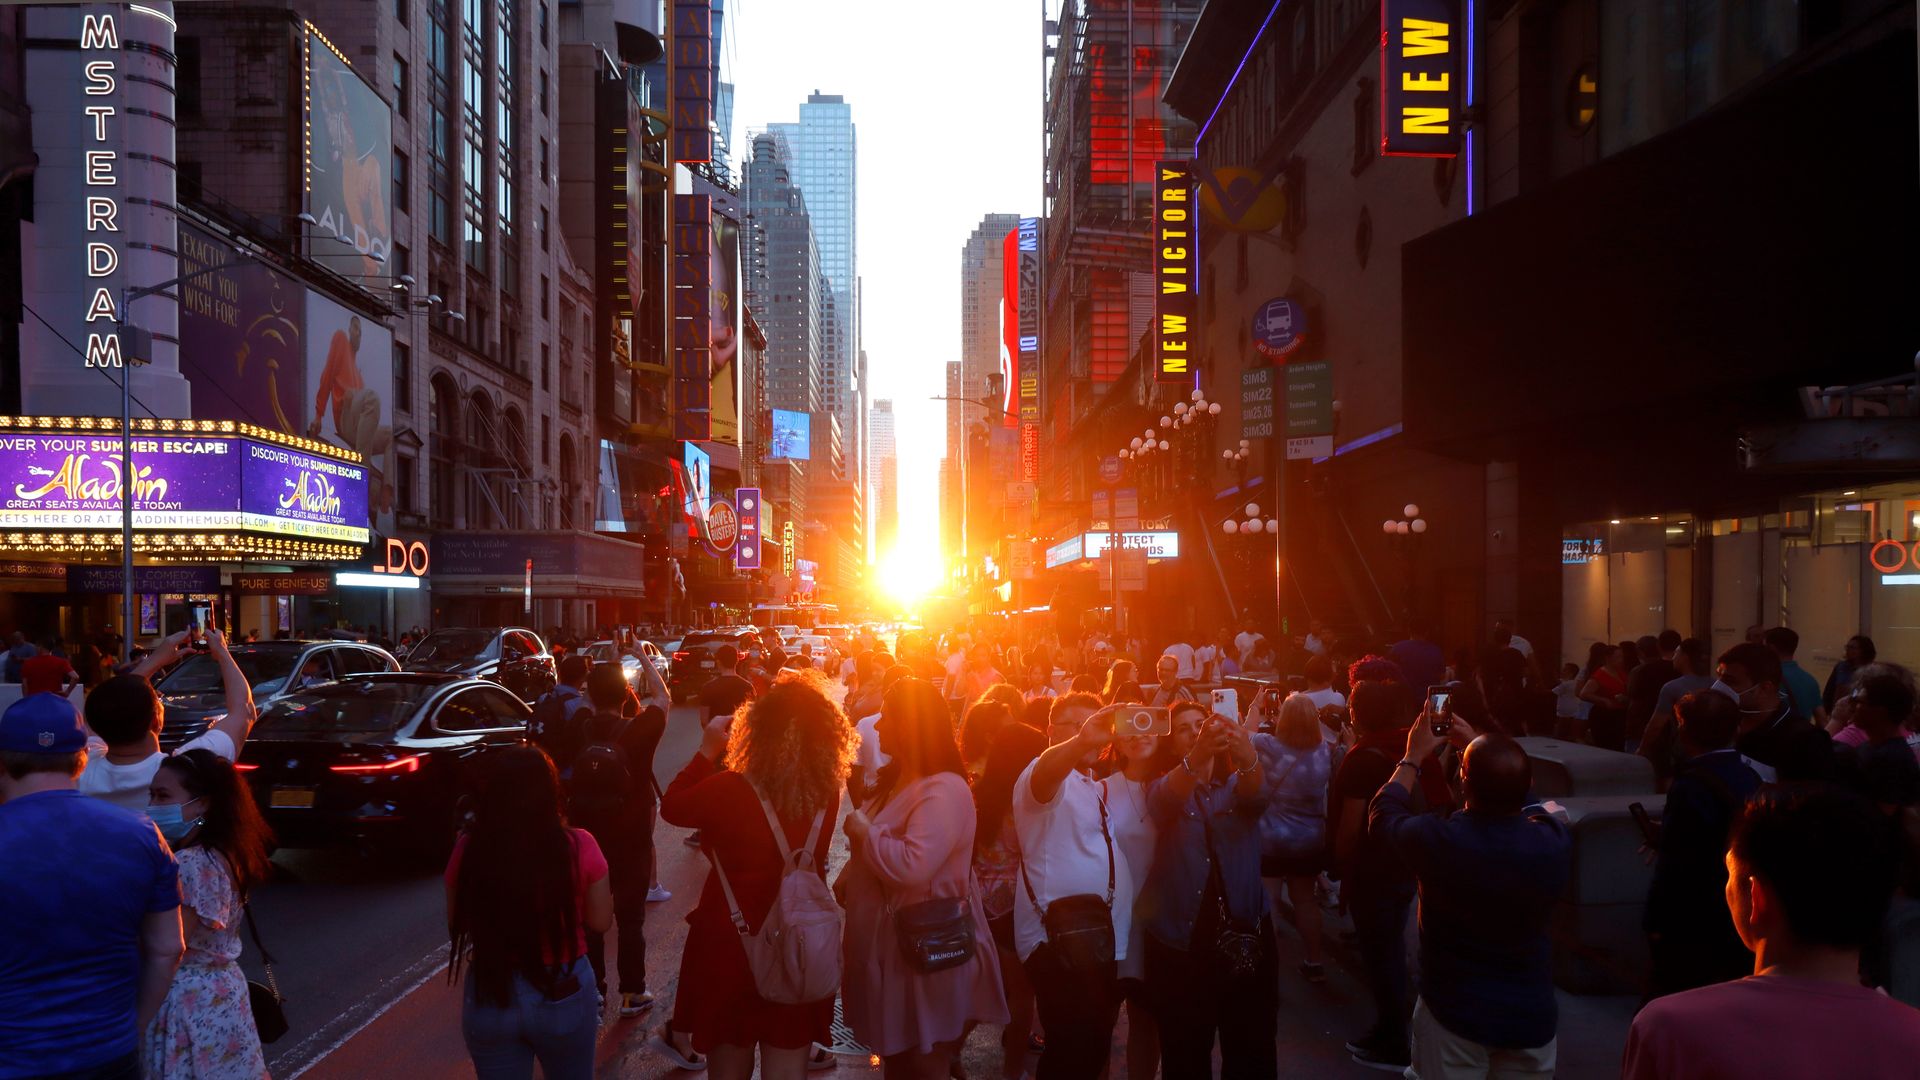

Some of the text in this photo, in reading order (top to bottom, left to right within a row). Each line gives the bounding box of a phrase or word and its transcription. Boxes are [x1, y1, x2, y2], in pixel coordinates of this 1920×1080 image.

[680, 0, 705, 159] ADAME
[1402, 18, 1449, 134] NEW
[81, 14, 122, 368] MSTERDAM
[1019, 218, 1037, 251] NEW
[1162, 169, 1187, 373] NEW VICTORY
[218, 274, 238, 303] YOU
[184, 286, 212, 317] WISH
[681, 196, 703, 436] TUSSAUDS
[1242, 370, 1267, 385] SIM8
[1242, 387, 1272, 402] SIM22
[1243, 423, 1272, 438] SIM30
[41, 440, 86, 452] YOUR
[163, 441, 228, 454] ESCAPE!
[251, 446, 362, 480] DISCOVER YOUR SUMMER ESCAPE!
[279, 470, 341, 516] Aladdin
[6, 500, 182, 510] GREAT SEATS AVAILAE TODAY!
[275, 508, 291, 517] GREAT
[292, 509, 307, 519] SEATS
[307, 512, 331, 522] AVAILABLE
[710, 511, 728, 528] DAVE
[1138, 519, 1170, 530] TORY
[34, 514, 67, 523] HERE
[73, 515, 91, 523] OR
[97, 515, 113, 523] AT
[279, 521, 290, 531] GET
[292, 522, 315, 533] TICKETS
[316, 524, 329, 535] HERE
[331, 526, 339, 535] OR
[339, 527, 346, 536] AT
[373, 538, 428, 576] DO
[1143, 546, 1164, 555] IDS
[17, 565, 57, 575] BROADWAY
[1013, 556, 1030, 567] 25
[146, 571, 196, 580] COMEDY
